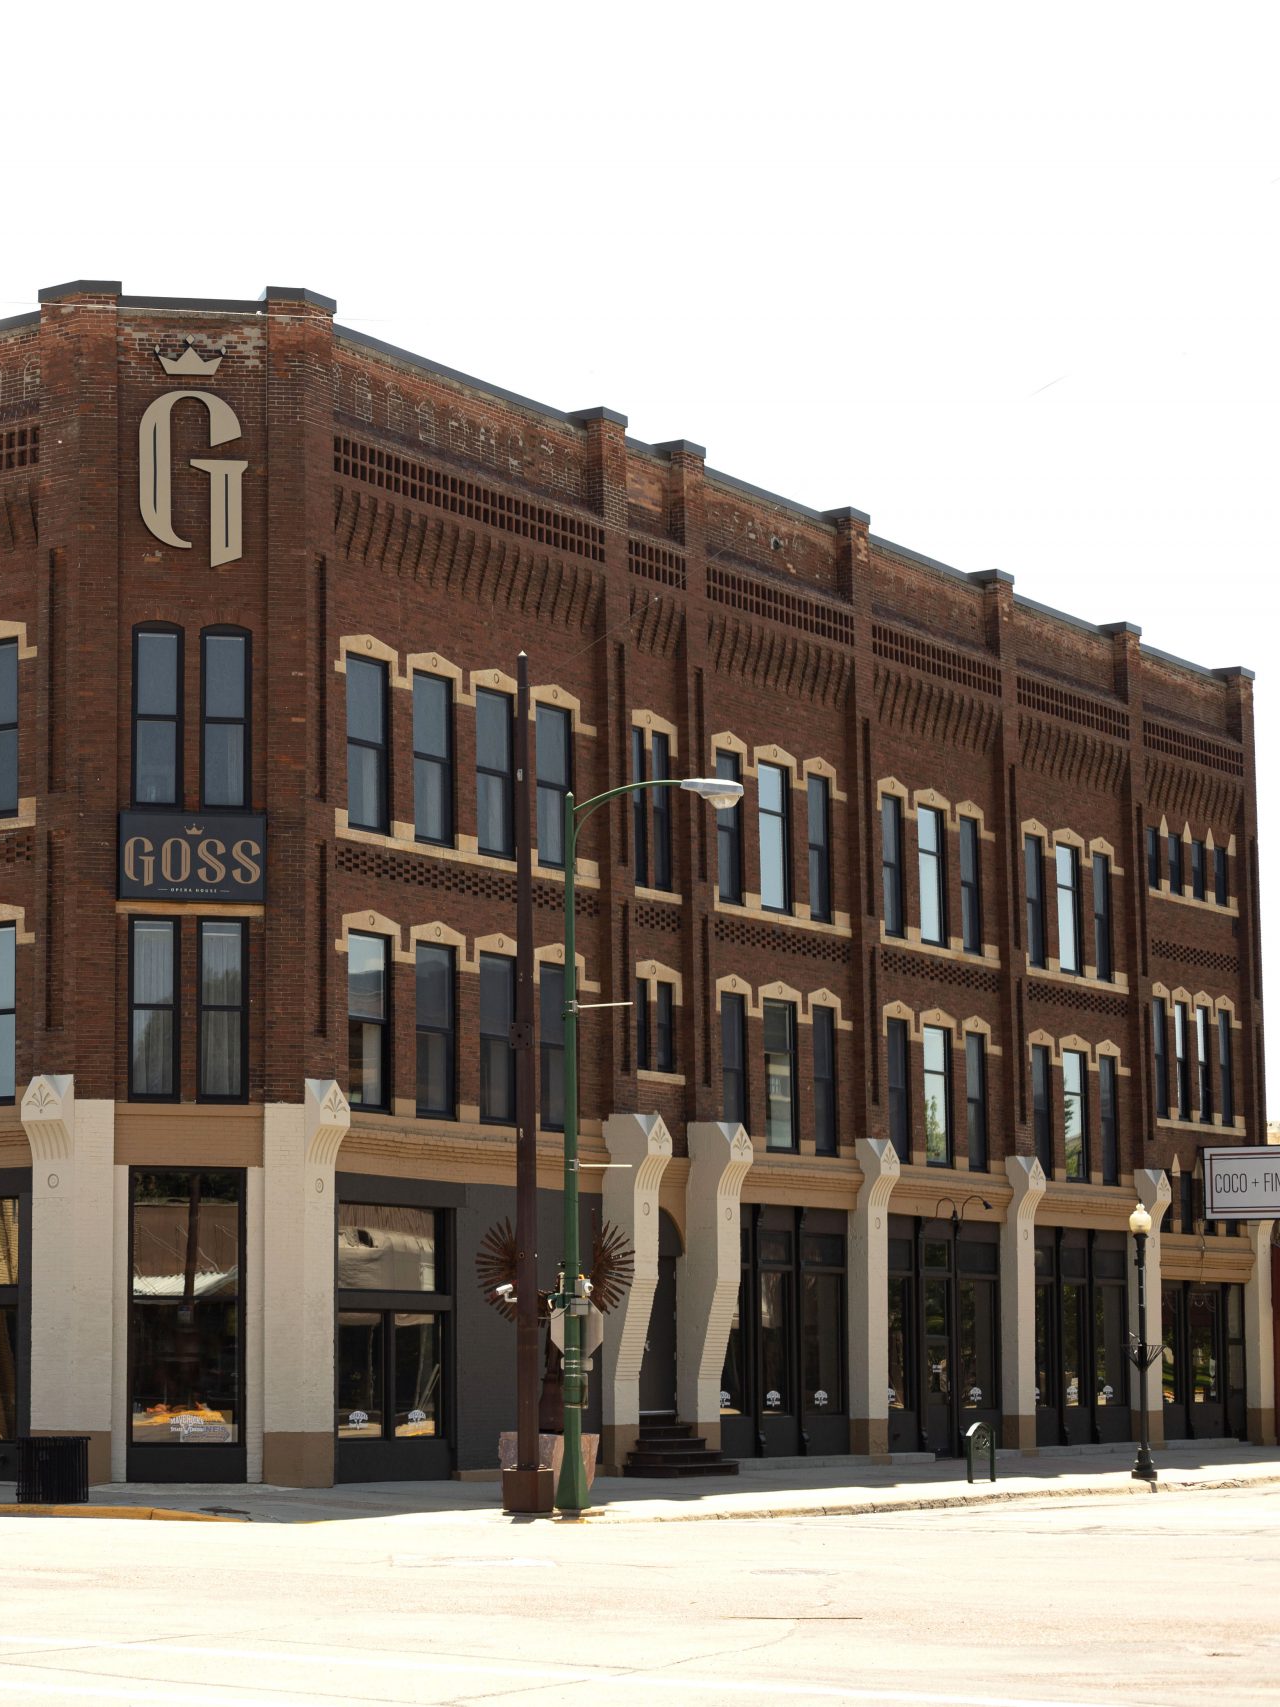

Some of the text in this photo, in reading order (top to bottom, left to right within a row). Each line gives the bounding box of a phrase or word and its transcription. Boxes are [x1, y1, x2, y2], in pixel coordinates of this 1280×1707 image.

[138, 390, 249, 568] G
[124, 836, 261, 887] GOSS
[1215, 1173, 1248, 1194] COCO
